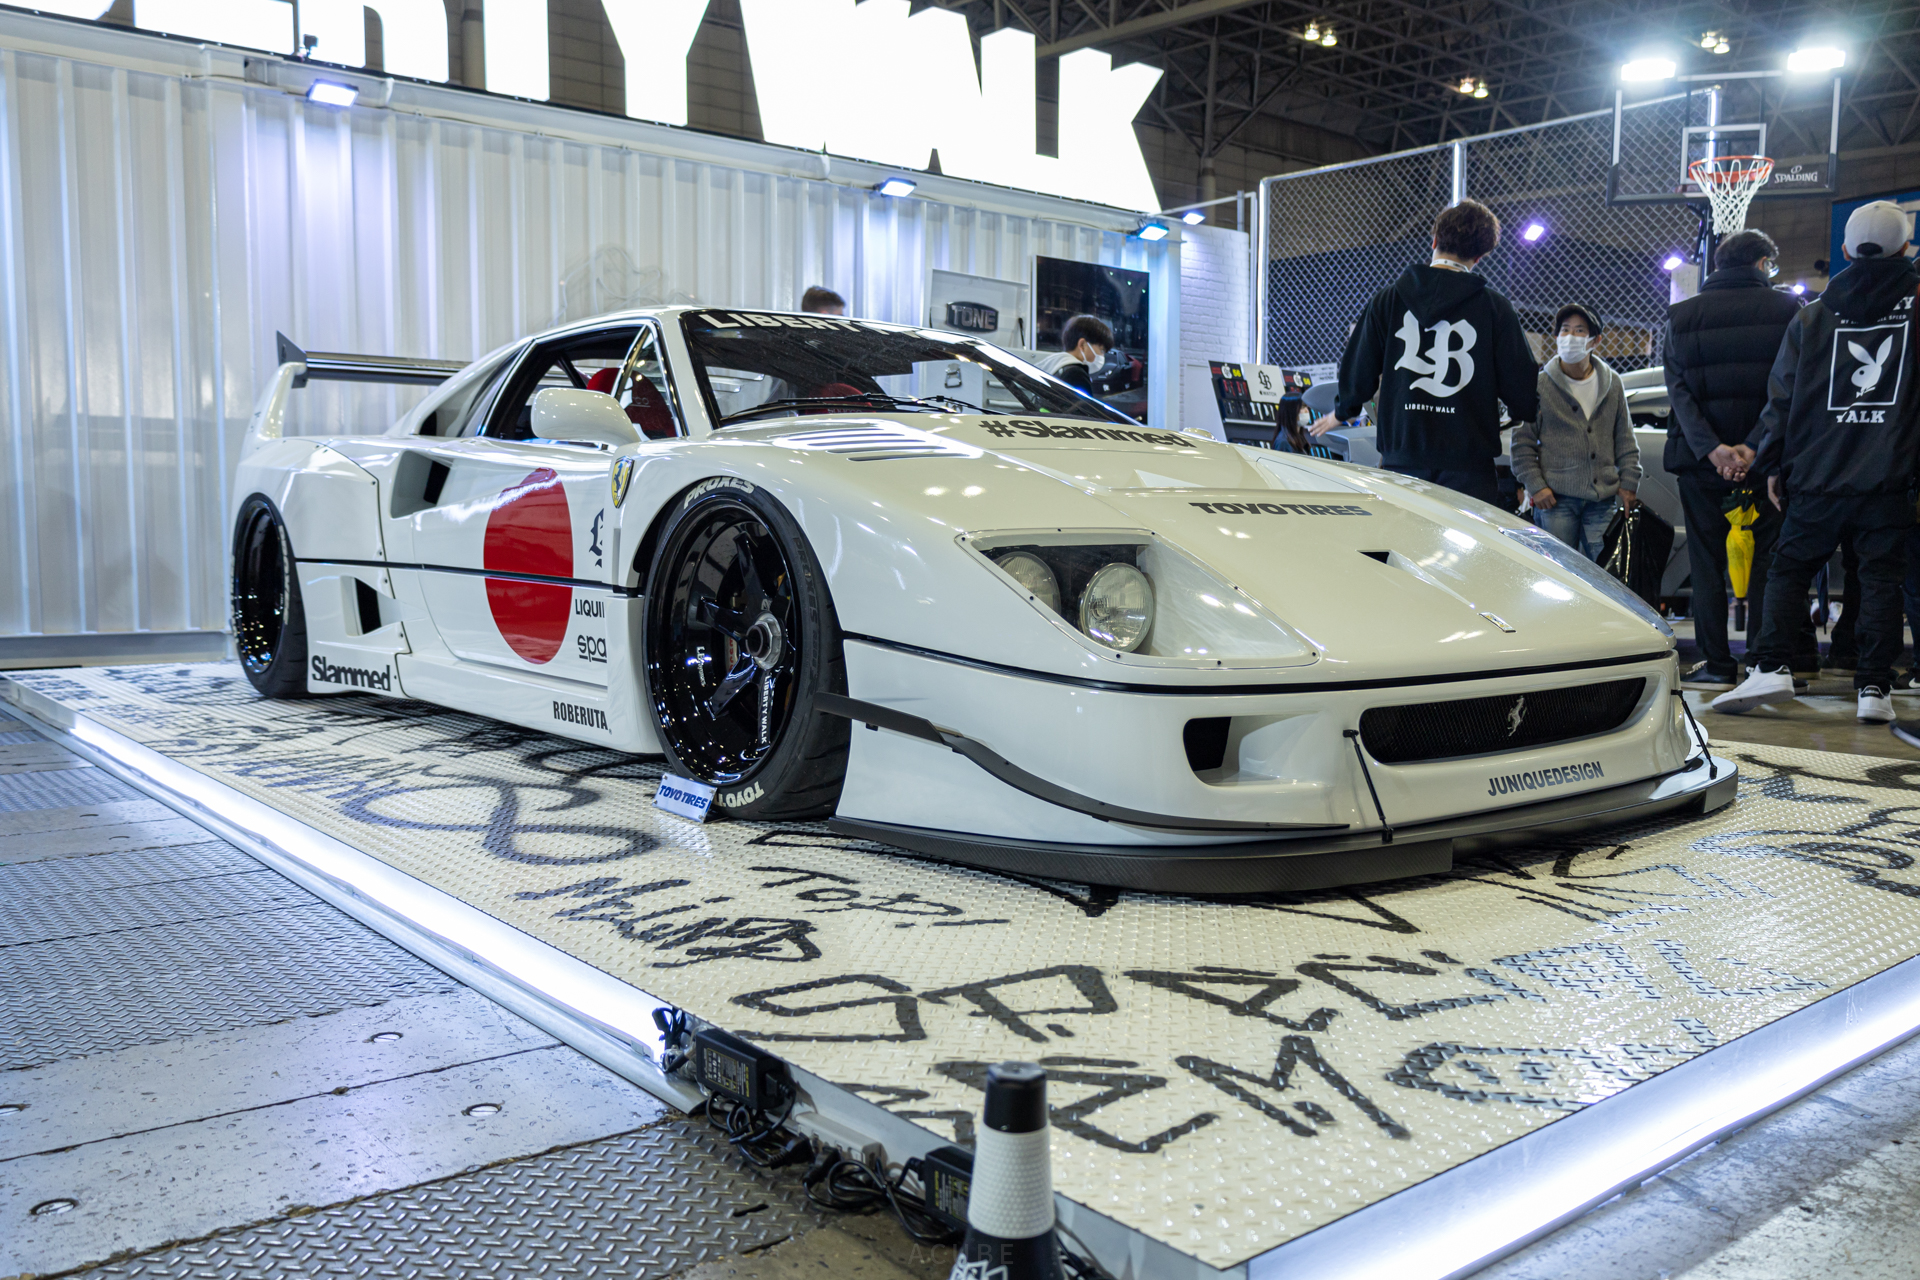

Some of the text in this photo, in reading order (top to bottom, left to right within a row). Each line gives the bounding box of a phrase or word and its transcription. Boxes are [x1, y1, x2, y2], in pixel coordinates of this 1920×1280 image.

[1775, 172, 1818, 183] SPALDING
[951, 304, 996, 330] TONE
[1404, 403, 1434, 412] LIBERTY
[979, 420, 1197, 448] #Slammed
[683, 476, 755, 509] PROXES
[311, 655, 391, 692] Slammed
[762, 676, 770, 716] LIBERTY
[552, 700, 609, 731] ROBERUTA
[1487, 761, 1605, 796] JUNIQUEDESIGN
